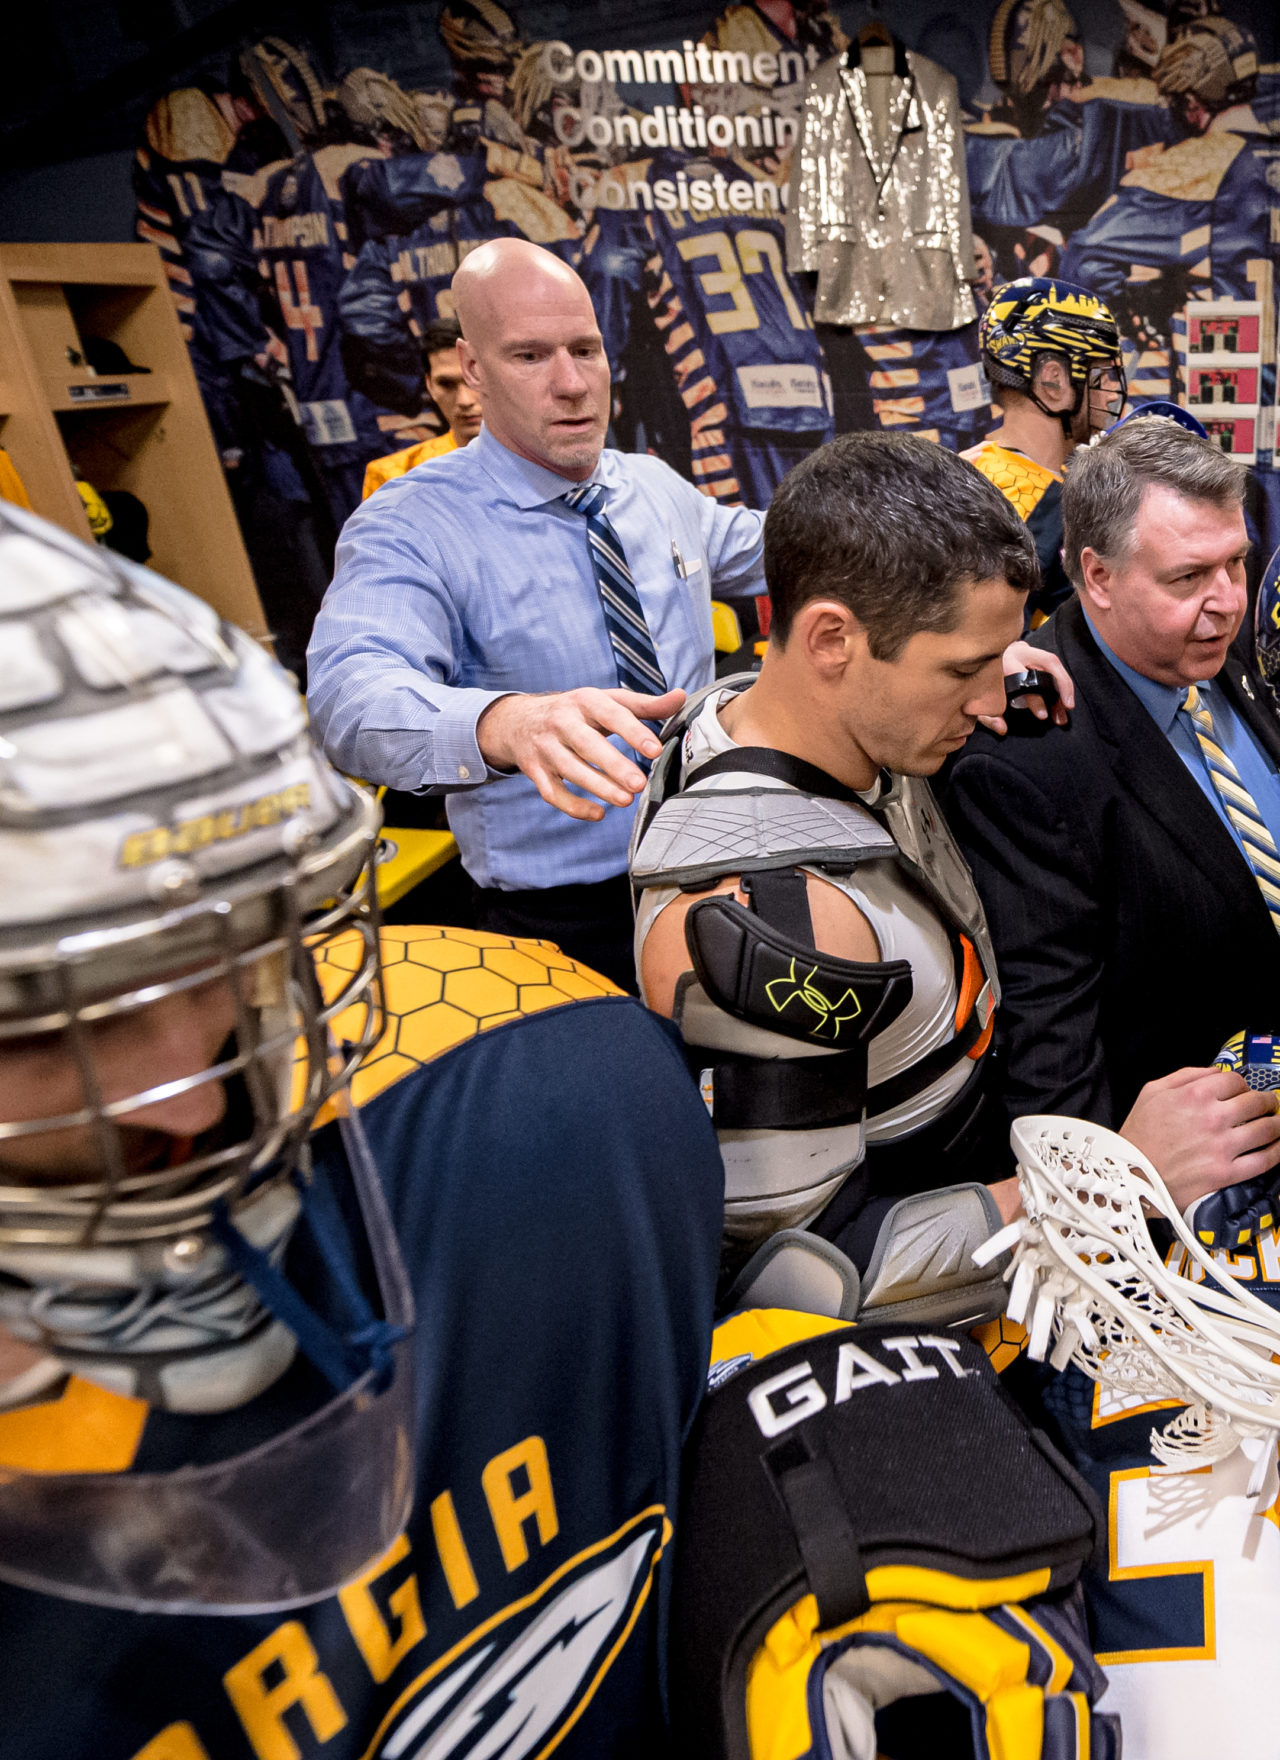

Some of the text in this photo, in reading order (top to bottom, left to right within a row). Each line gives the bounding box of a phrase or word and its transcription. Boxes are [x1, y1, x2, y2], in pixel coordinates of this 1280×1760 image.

[546, 39, 821, 85] Commitment
[553, 105, 801, 149] Conditionin
[567, 170, 791, 211] Consisten
[274, 260, 324, 362] 4
[676, 229, 808, 335] 37
[746, 1334, 961, 1439] GAIT
[129, 1435, 560, 1760] RGIA
